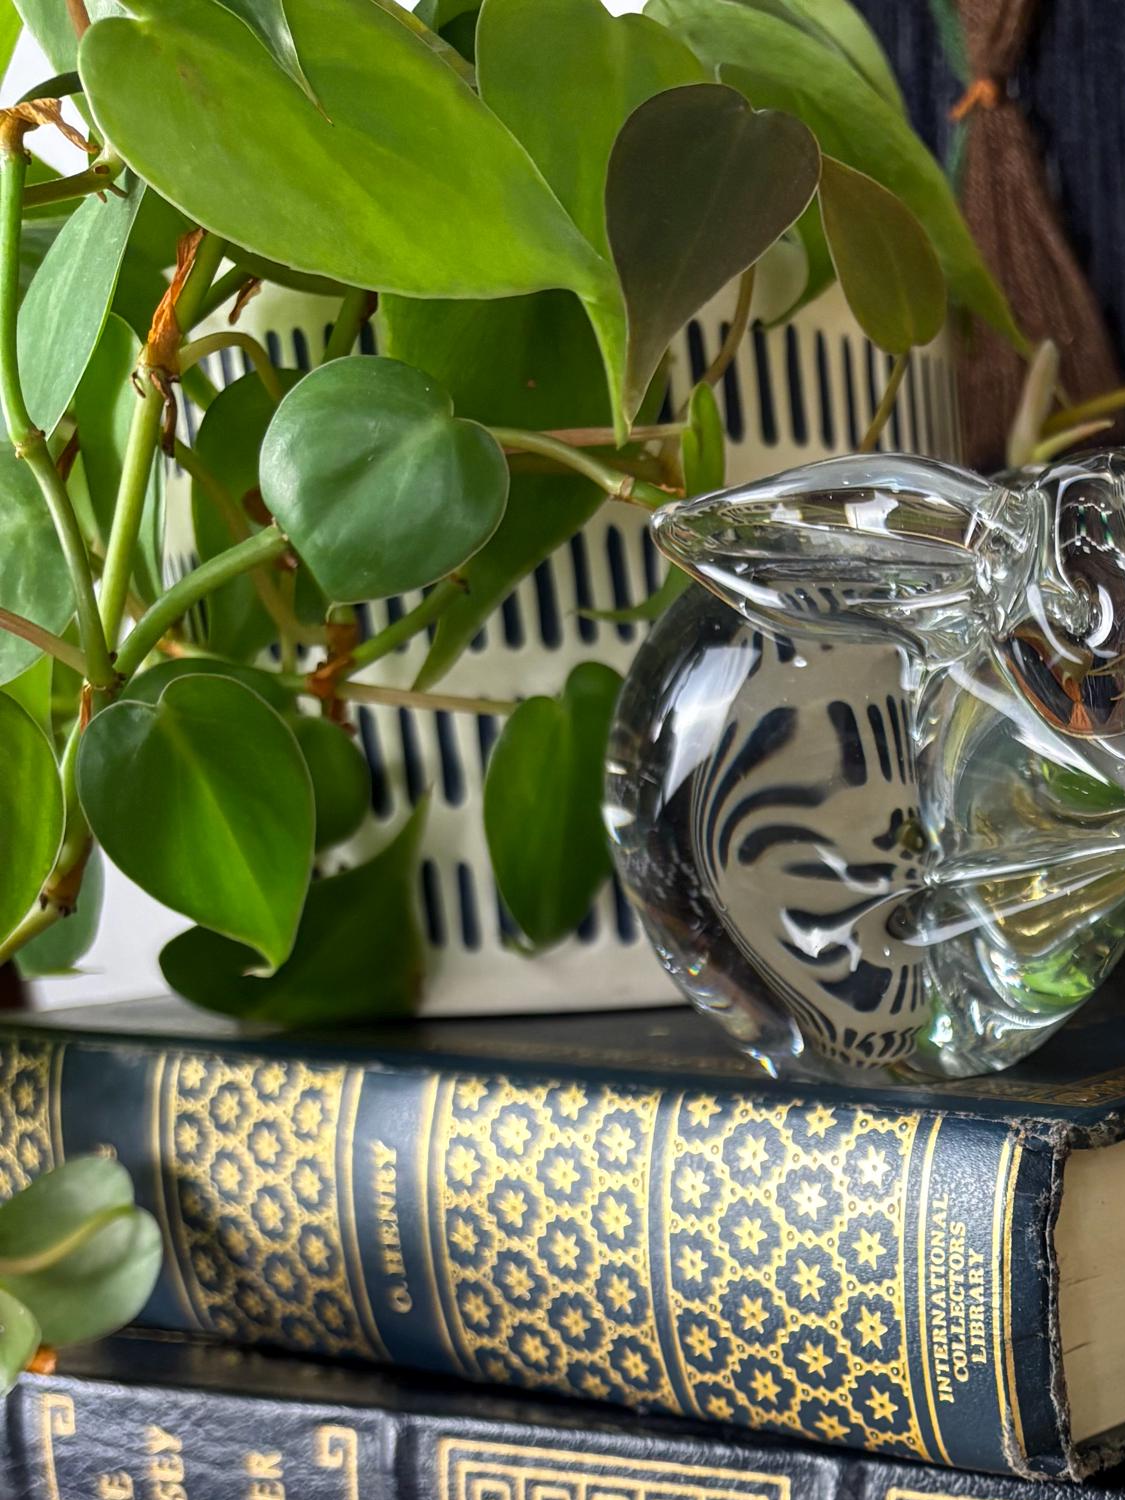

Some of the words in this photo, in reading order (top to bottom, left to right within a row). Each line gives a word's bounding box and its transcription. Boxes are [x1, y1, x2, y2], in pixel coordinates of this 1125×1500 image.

[370, 1139, 406, 1276] HENRY
[929, 1192, 955, 1404] INTERNATIONAL
[949, 1221, 969, 1383] COLLECTORS
[968, 1247, 987, 1364] LIBRARY
